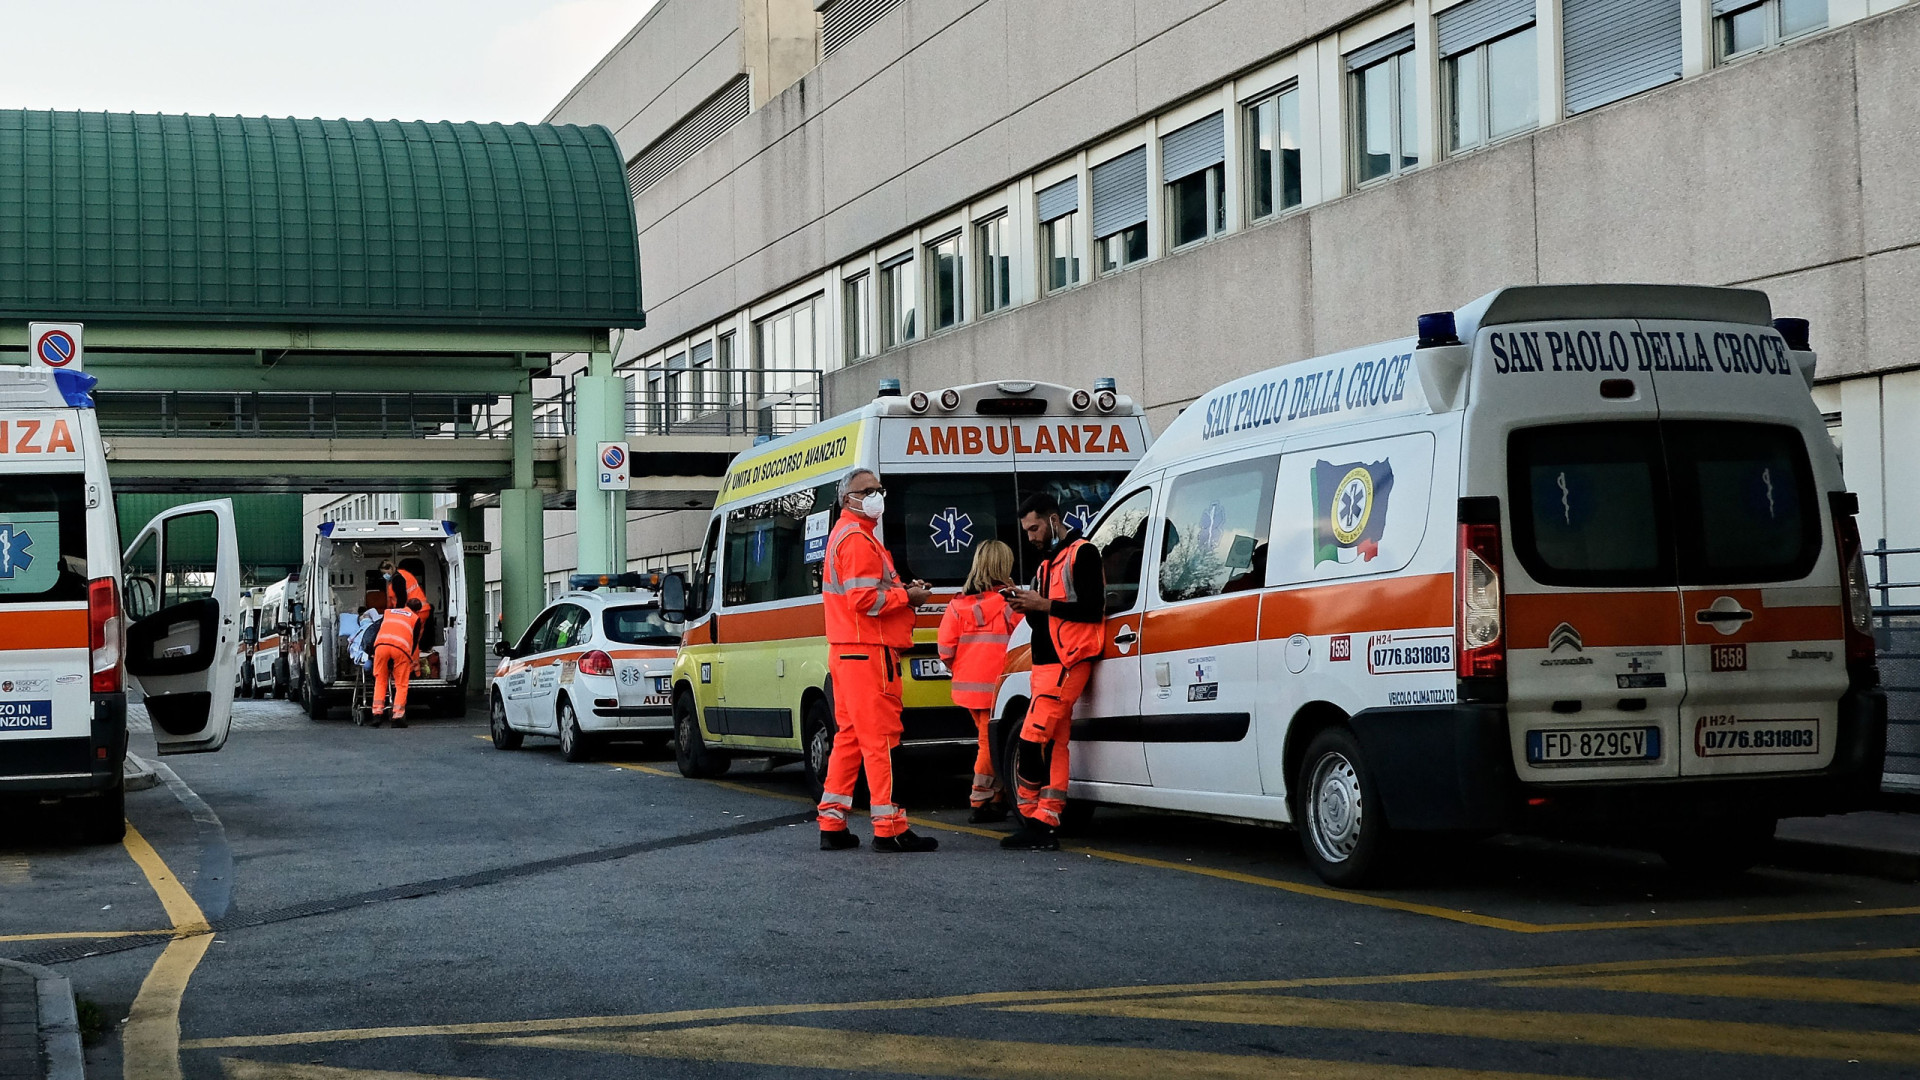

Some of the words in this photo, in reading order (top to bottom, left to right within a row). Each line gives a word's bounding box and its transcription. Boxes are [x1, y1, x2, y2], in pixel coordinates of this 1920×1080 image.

[1490, 332, 1543, 374] SAN
[1545, 331, 1629, 373] PAOLO
[1631, 332, 1713, 372] DELLA
[1713, 332, 1791, 375] CROCE
[1203, 392, 1238, 441] SAN
[1234, 378, 1288, 432] PAOLO
[1288, 367, 1344, 421] DELLA
[1347, 353, 1412, 410] CROCE
[906, 425, 1130, 456] AMBULANZA
[752, 465, 761, 484] DI
[761, 451, 803, 481] SOCCORSO
[803, 436, 847, 468] AVANZATO
[1331, 640, 1349, 658] 1558
[1376, 635, 1392, 645] H24
[1374, 646, 1451, 667] 0776.831803
[1714, 648, 1743, 668] 1558
[1388, 691, 1412, 705] VEICOLO
[1412, 689, 1455, 704] CLIMATIZZATO
[19, 704, 31, 714] IN
[1709, 715, 1735, 727] H24
[1580, 731, 1644, 757] 829GV
[1705, 729, 1813, 749] 0776.831803
